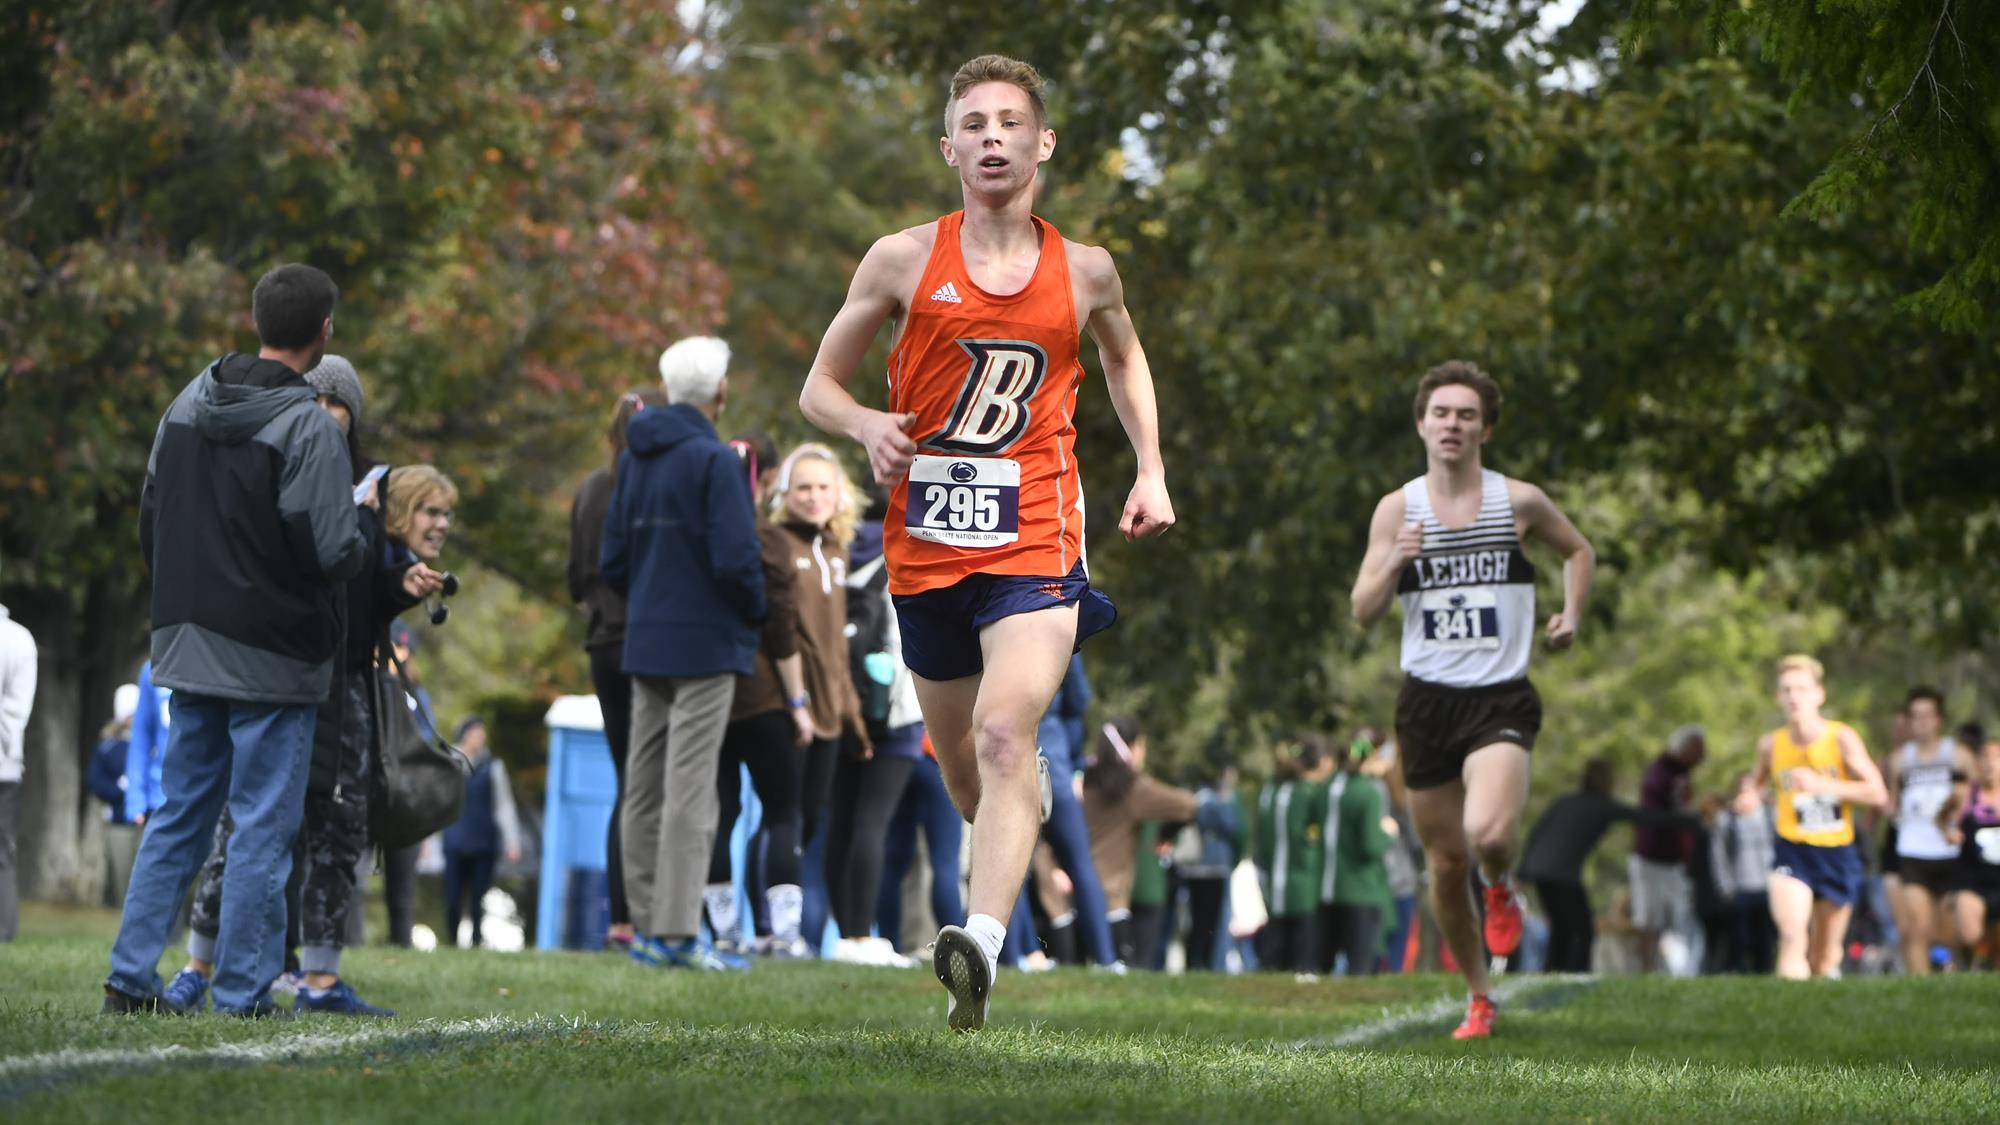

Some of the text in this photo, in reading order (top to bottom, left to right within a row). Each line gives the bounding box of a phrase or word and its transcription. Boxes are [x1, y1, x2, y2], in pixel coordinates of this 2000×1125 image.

[931, 293, 962, 304] adidas
[918, 339, 1048, 455] B
[923, 486, 1000, 530] 295
[1414, 551, 1510, 587] LEHIGH
[1433, 609, 1482, 638] 341
